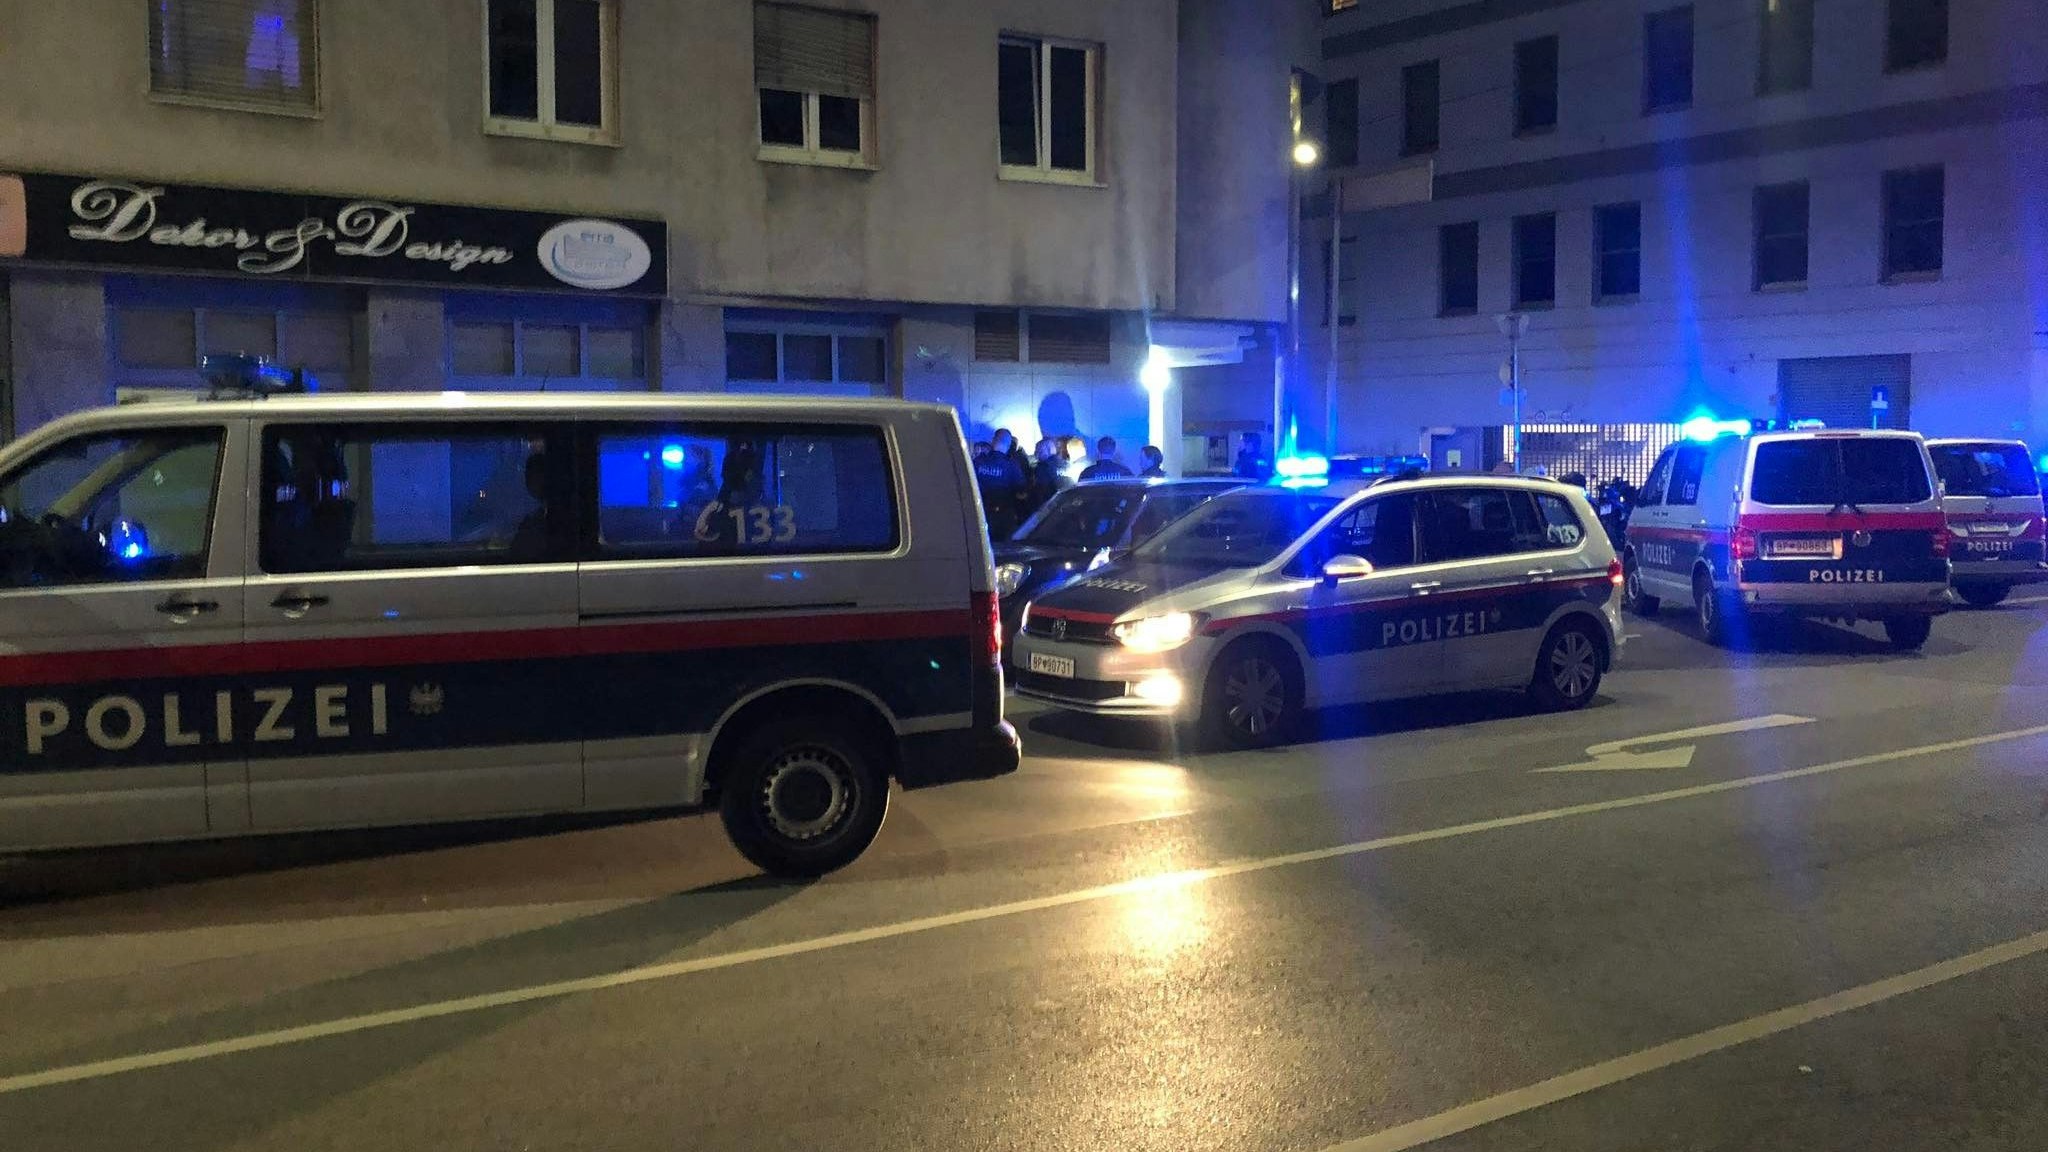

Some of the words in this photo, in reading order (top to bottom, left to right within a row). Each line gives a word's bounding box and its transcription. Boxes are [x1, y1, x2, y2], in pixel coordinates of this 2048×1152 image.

[68, 180, 259, 250] Dekor
[237, 217, 336, 274] &
[334, 199, 514, 272] Design
[728, 505, 797, 544] 133
[1967, 541, 2014, 552] POLIZEI
[1809, 569, 1884, 582] POLIZEI
[1382, 610, 1486, 646] POLIZEI
[25, 682, 388, 755] POLIZEI
